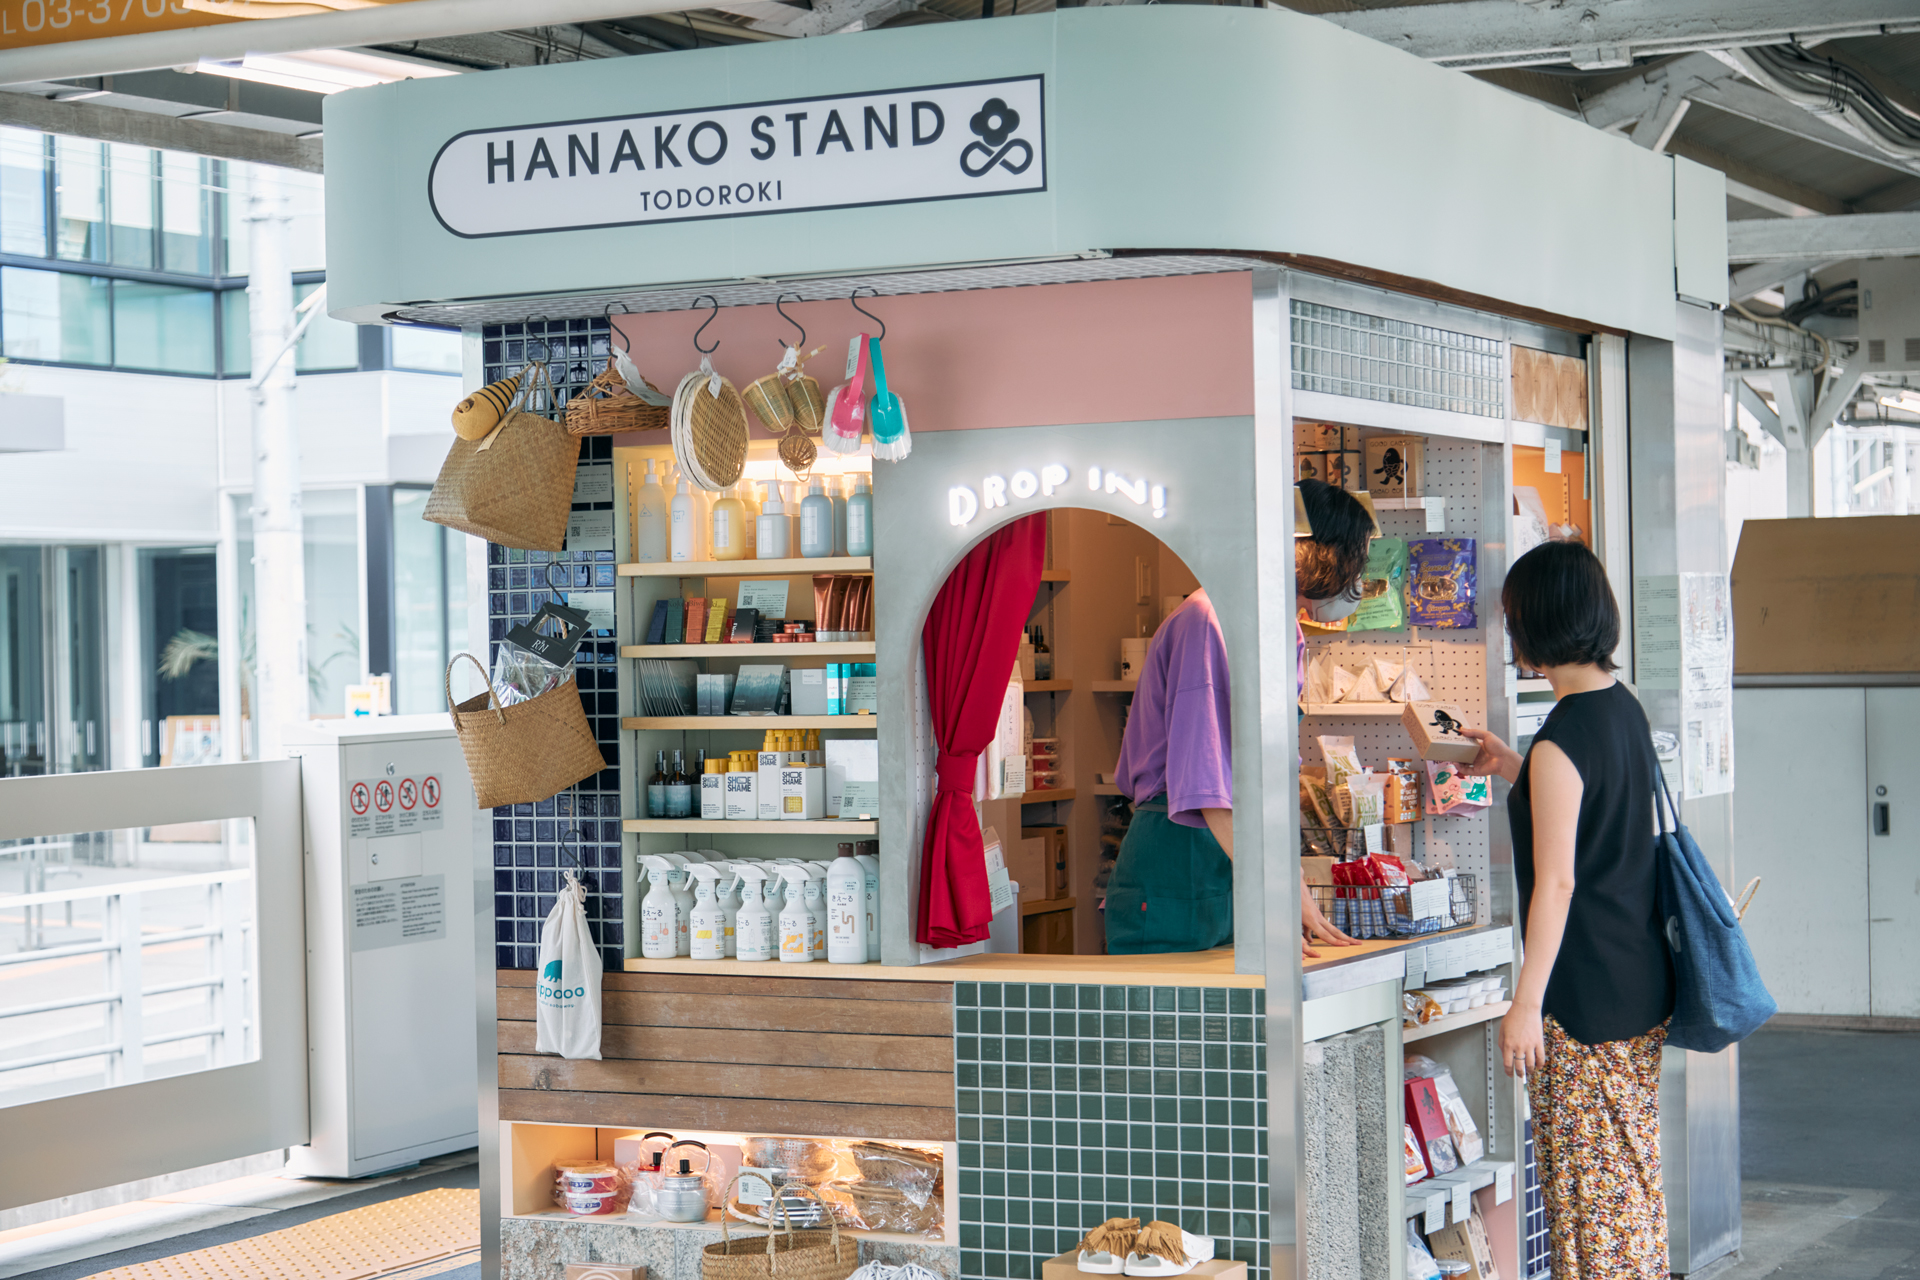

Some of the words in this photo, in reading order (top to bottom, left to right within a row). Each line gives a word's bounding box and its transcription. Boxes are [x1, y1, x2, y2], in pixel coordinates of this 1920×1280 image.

[486, 120, 729, 185] HANAKO
[750, 100, 945, 161] STAND
[640, 180, 783, 212] TODOROKI
[949, 463, 1070, 526] DROP
[1087, 465, 1167, 519] IN!
[1420, 560, 1453, 573] Sweet
[727, 776, 752, 785] SHOE
[781, 771, 803, 779] SHOE
[727, 784, 752, 793] SHAME
[781, 778, 803, 786] SHAME
[535, 979, 585, 1000] ippooo
